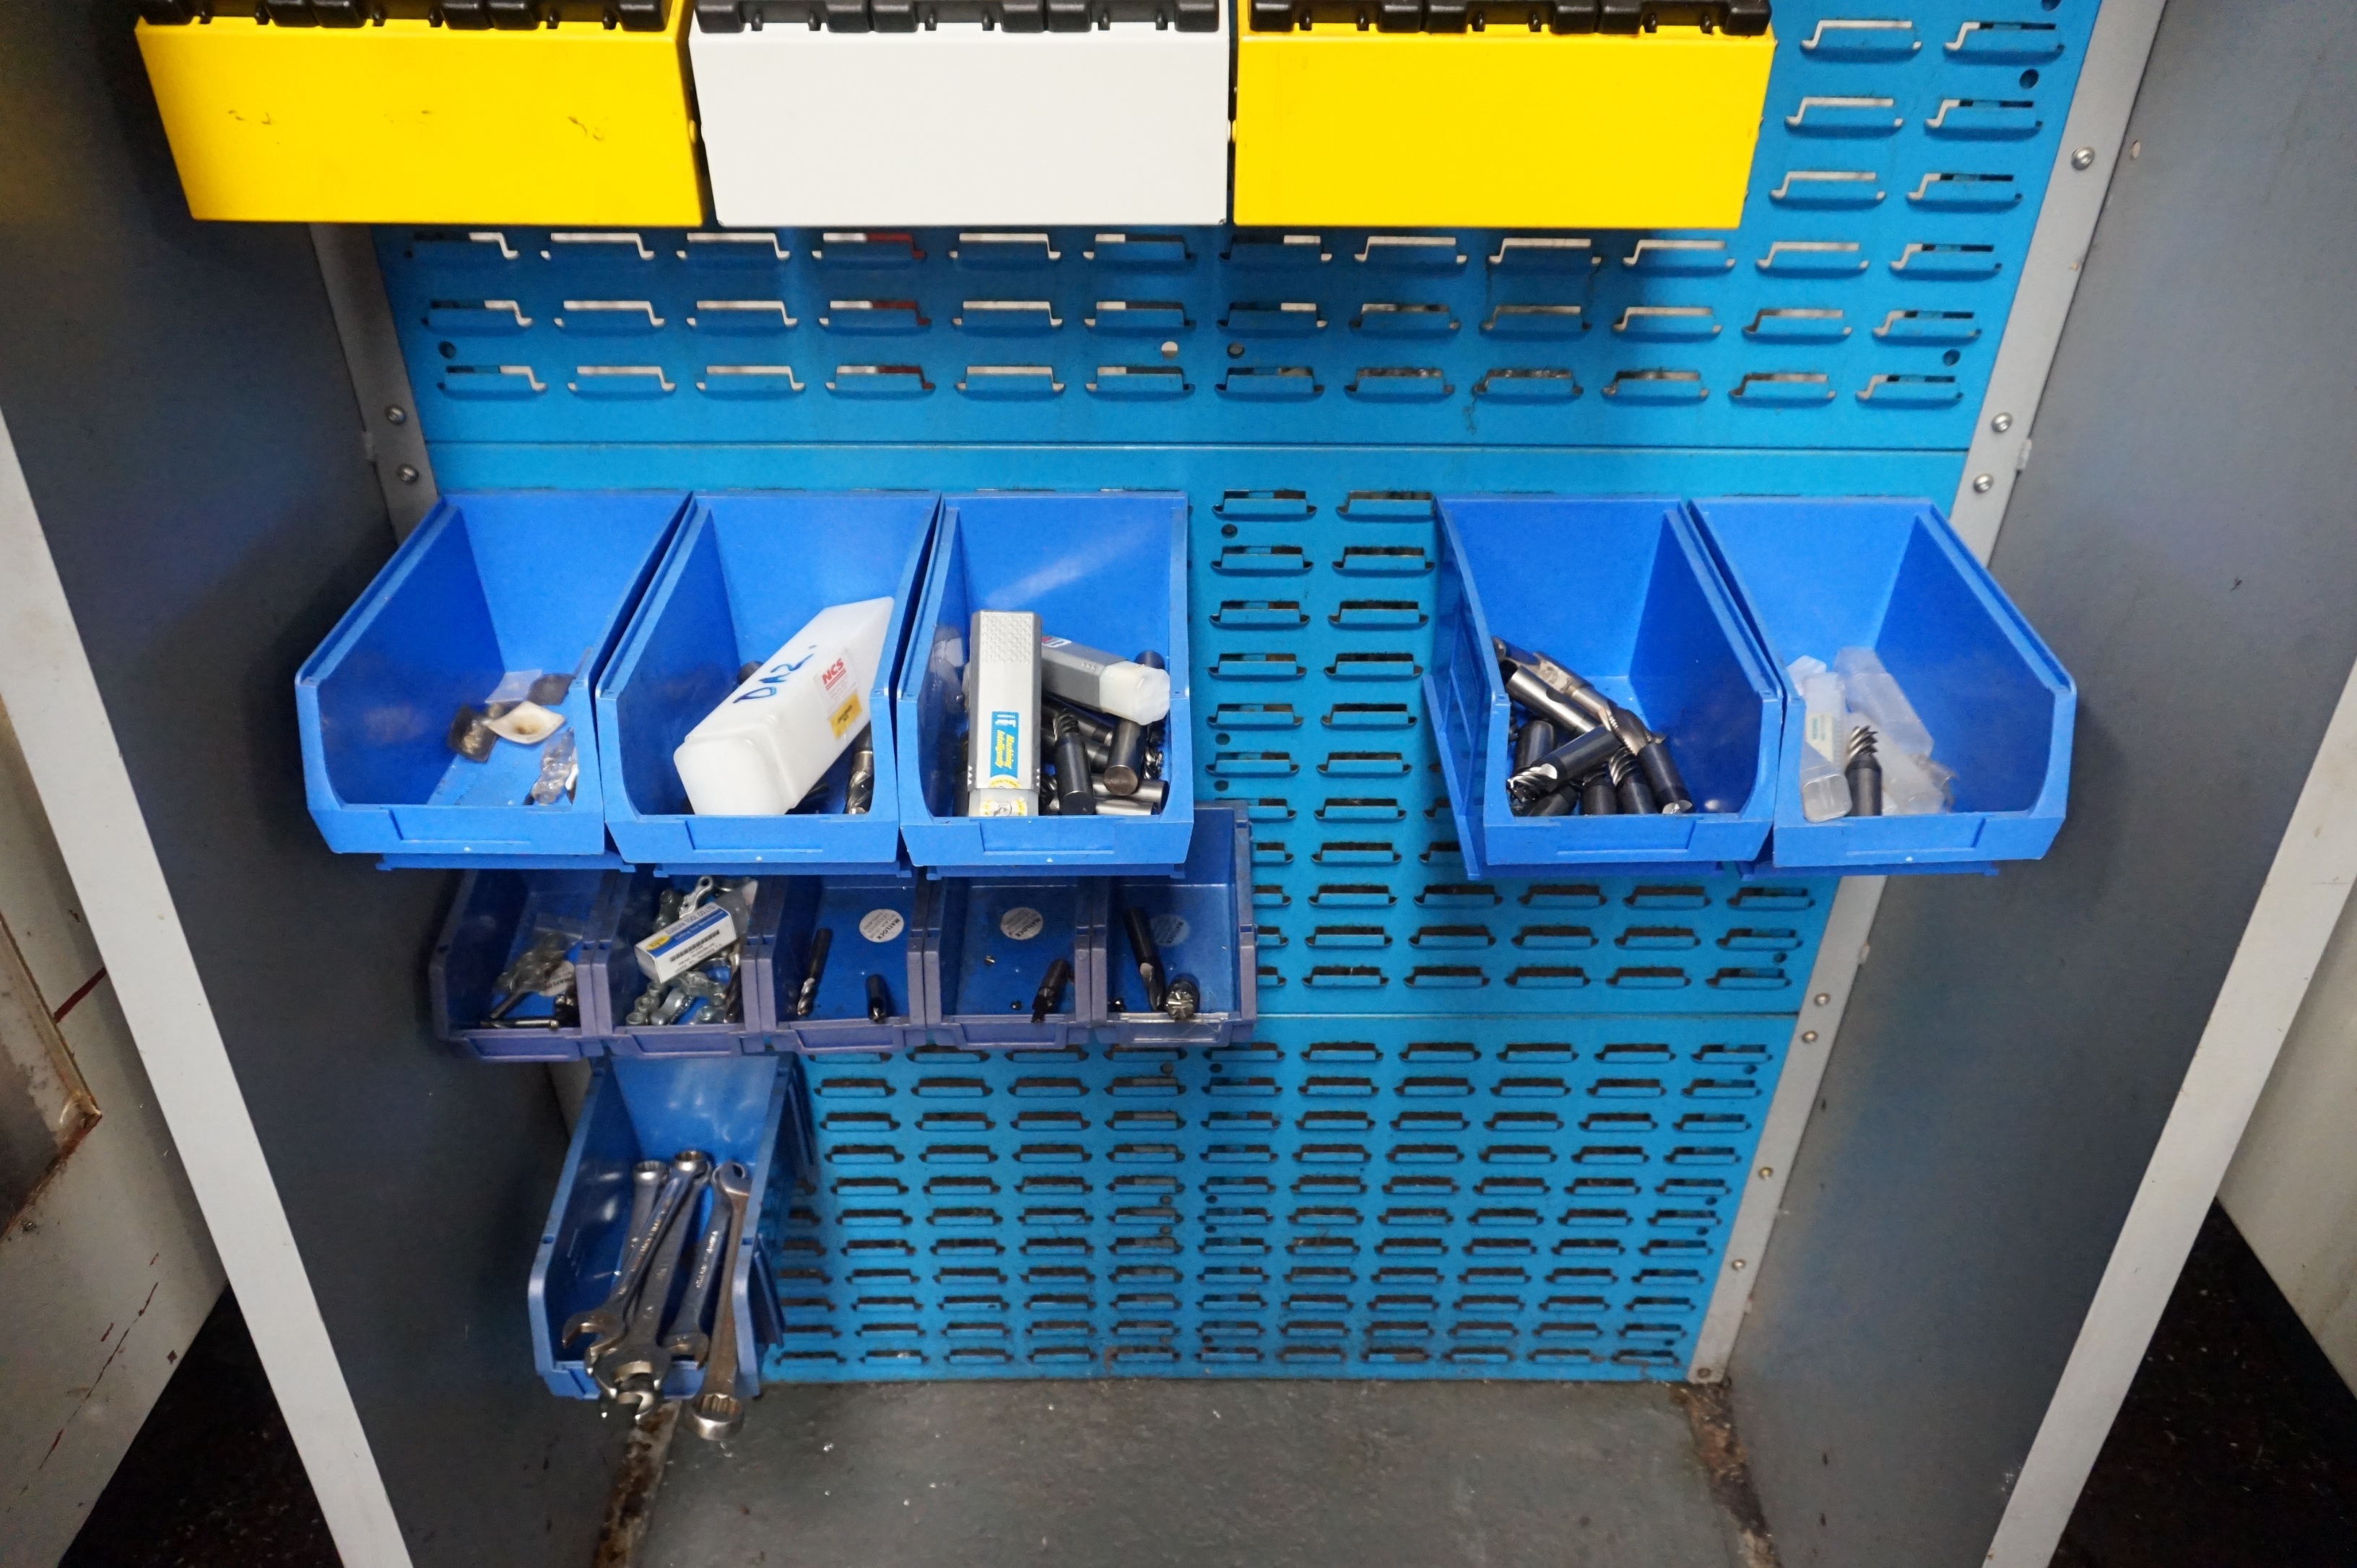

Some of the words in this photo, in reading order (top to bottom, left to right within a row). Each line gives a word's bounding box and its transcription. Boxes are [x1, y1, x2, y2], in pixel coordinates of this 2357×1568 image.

[821, 657, 844, 685] NCS
[994, 729, 1005, 769] Intelligently
[1004, 733, 1015, 770] Machining
[665, 920, 687, 936] EUROPA
[685, 914, 698, 925] TOOL
[876, 918, 900, 941] MATLOCK
[1015, 917, 1041, 937] MATLOCK
